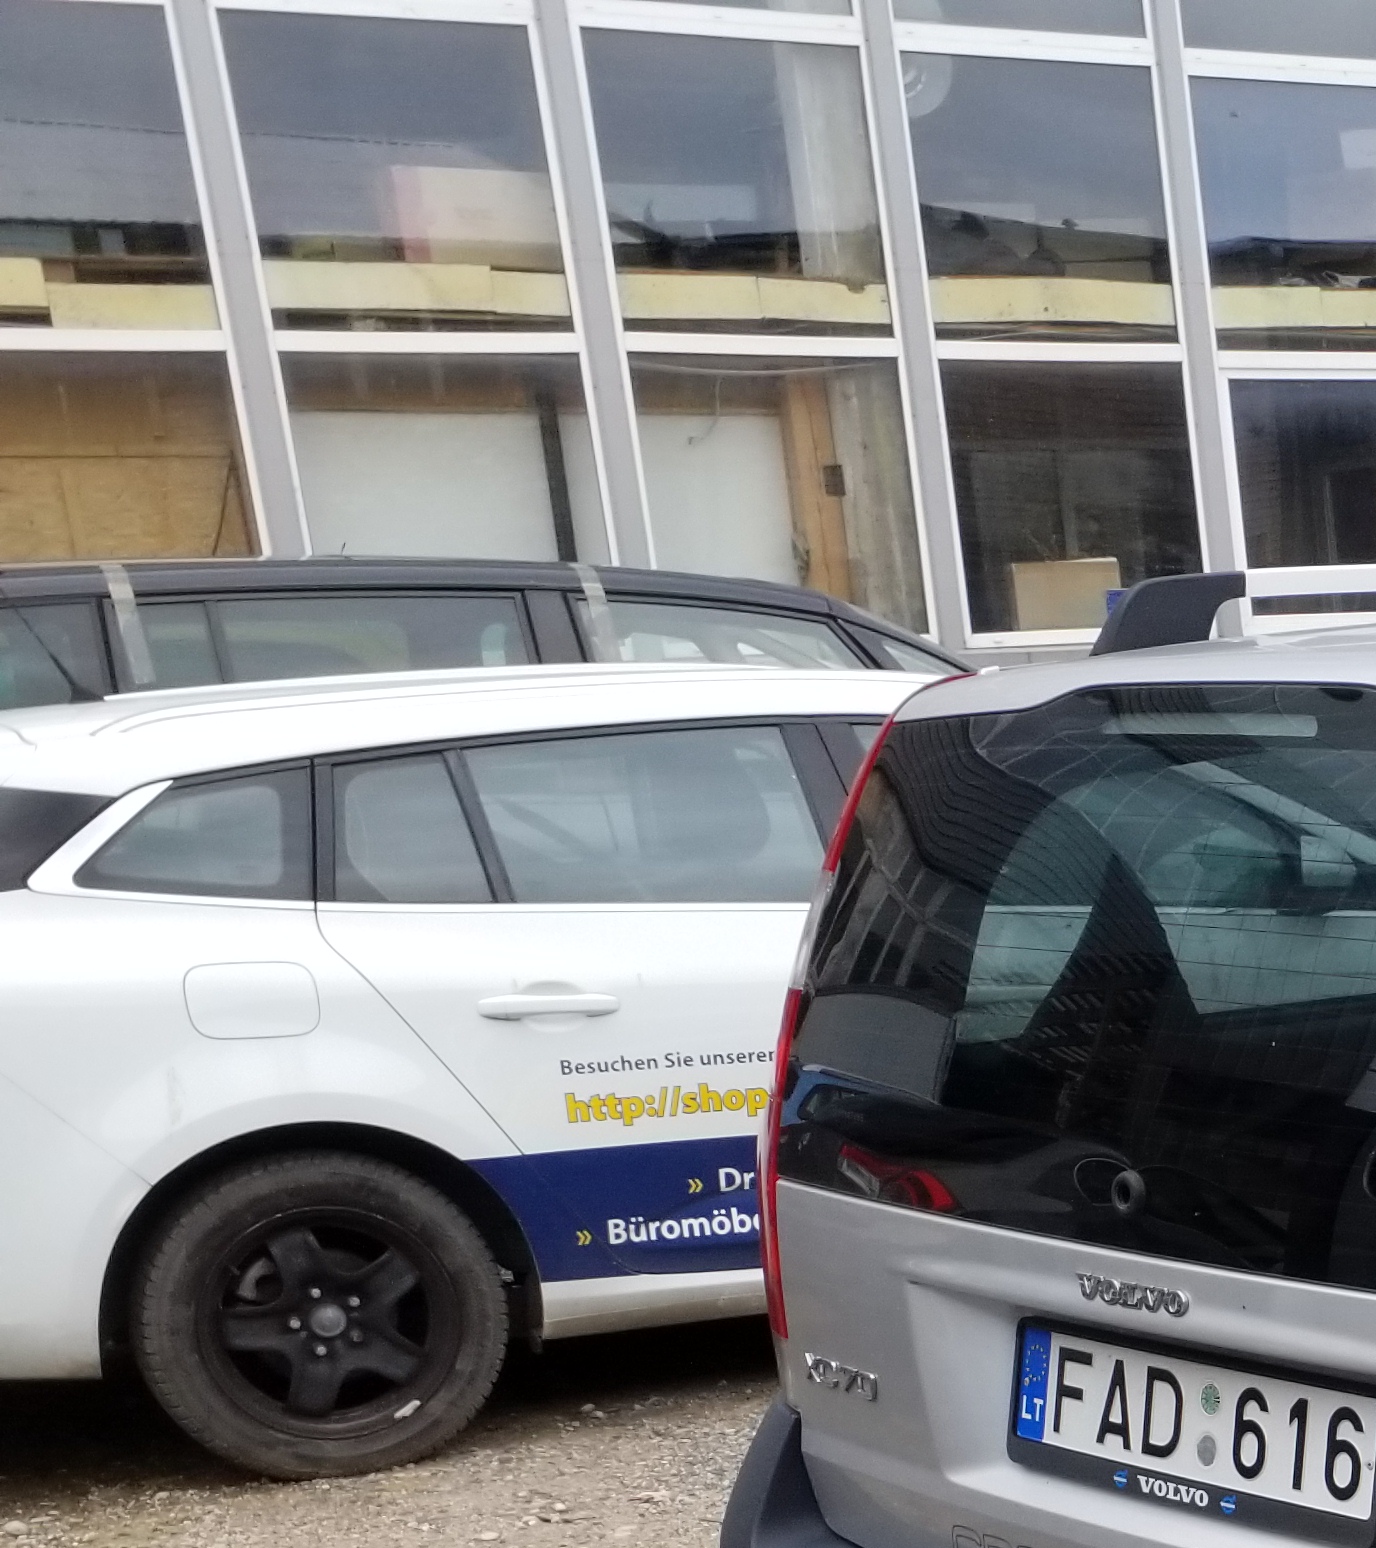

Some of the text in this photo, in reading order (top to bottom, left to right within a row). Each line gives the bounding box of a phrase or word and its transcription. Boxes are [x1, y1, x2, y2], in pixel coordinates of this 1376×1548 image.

[560, 1054, 658, 1075] Besuchen
[664, 1052, 694, 1068] Sie
[564, 1083, 769, 1126] http://shop
[1076, 1272, 1190, 1317] VOLVO
[1021, 1394, 1044, 1422] LT
[1053, 1346, 1365, 1501] FAD 616
[1137, 1474, 1209, 1507] VOLVO
